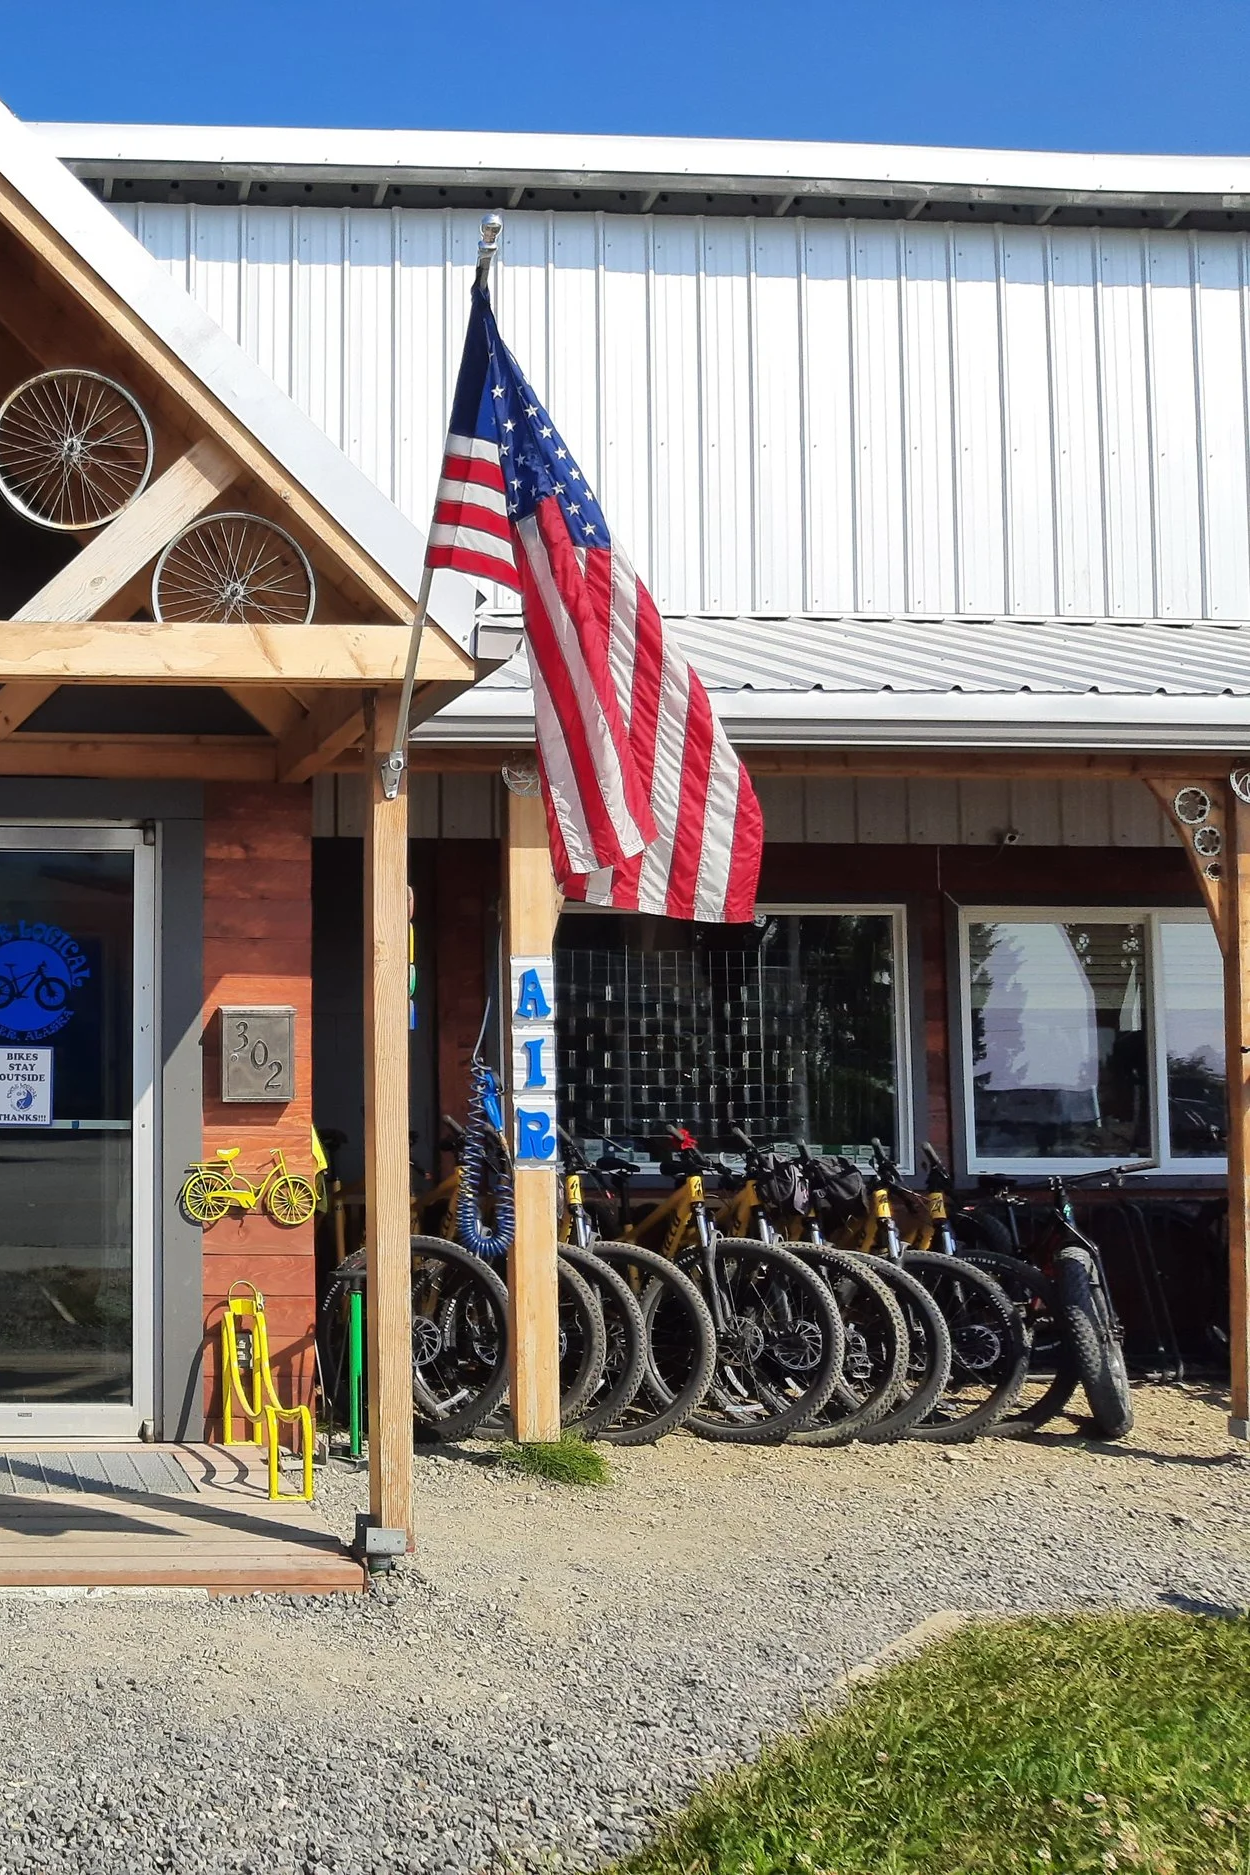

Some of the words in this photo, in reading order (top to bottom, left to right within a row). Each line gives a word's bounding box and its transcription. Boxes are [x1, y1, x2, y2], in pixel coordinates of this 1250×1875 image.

[17, 919, 91, 987] LOGICAL
[25, 1009, 74, 1040] ALASKA
[6, 1052, 38, 1061] BIKES
[8, 1063, 36, 1071] STAY
[233, 1020, 283, 1091] 302
[515, 967, 556, 1159] AIR
